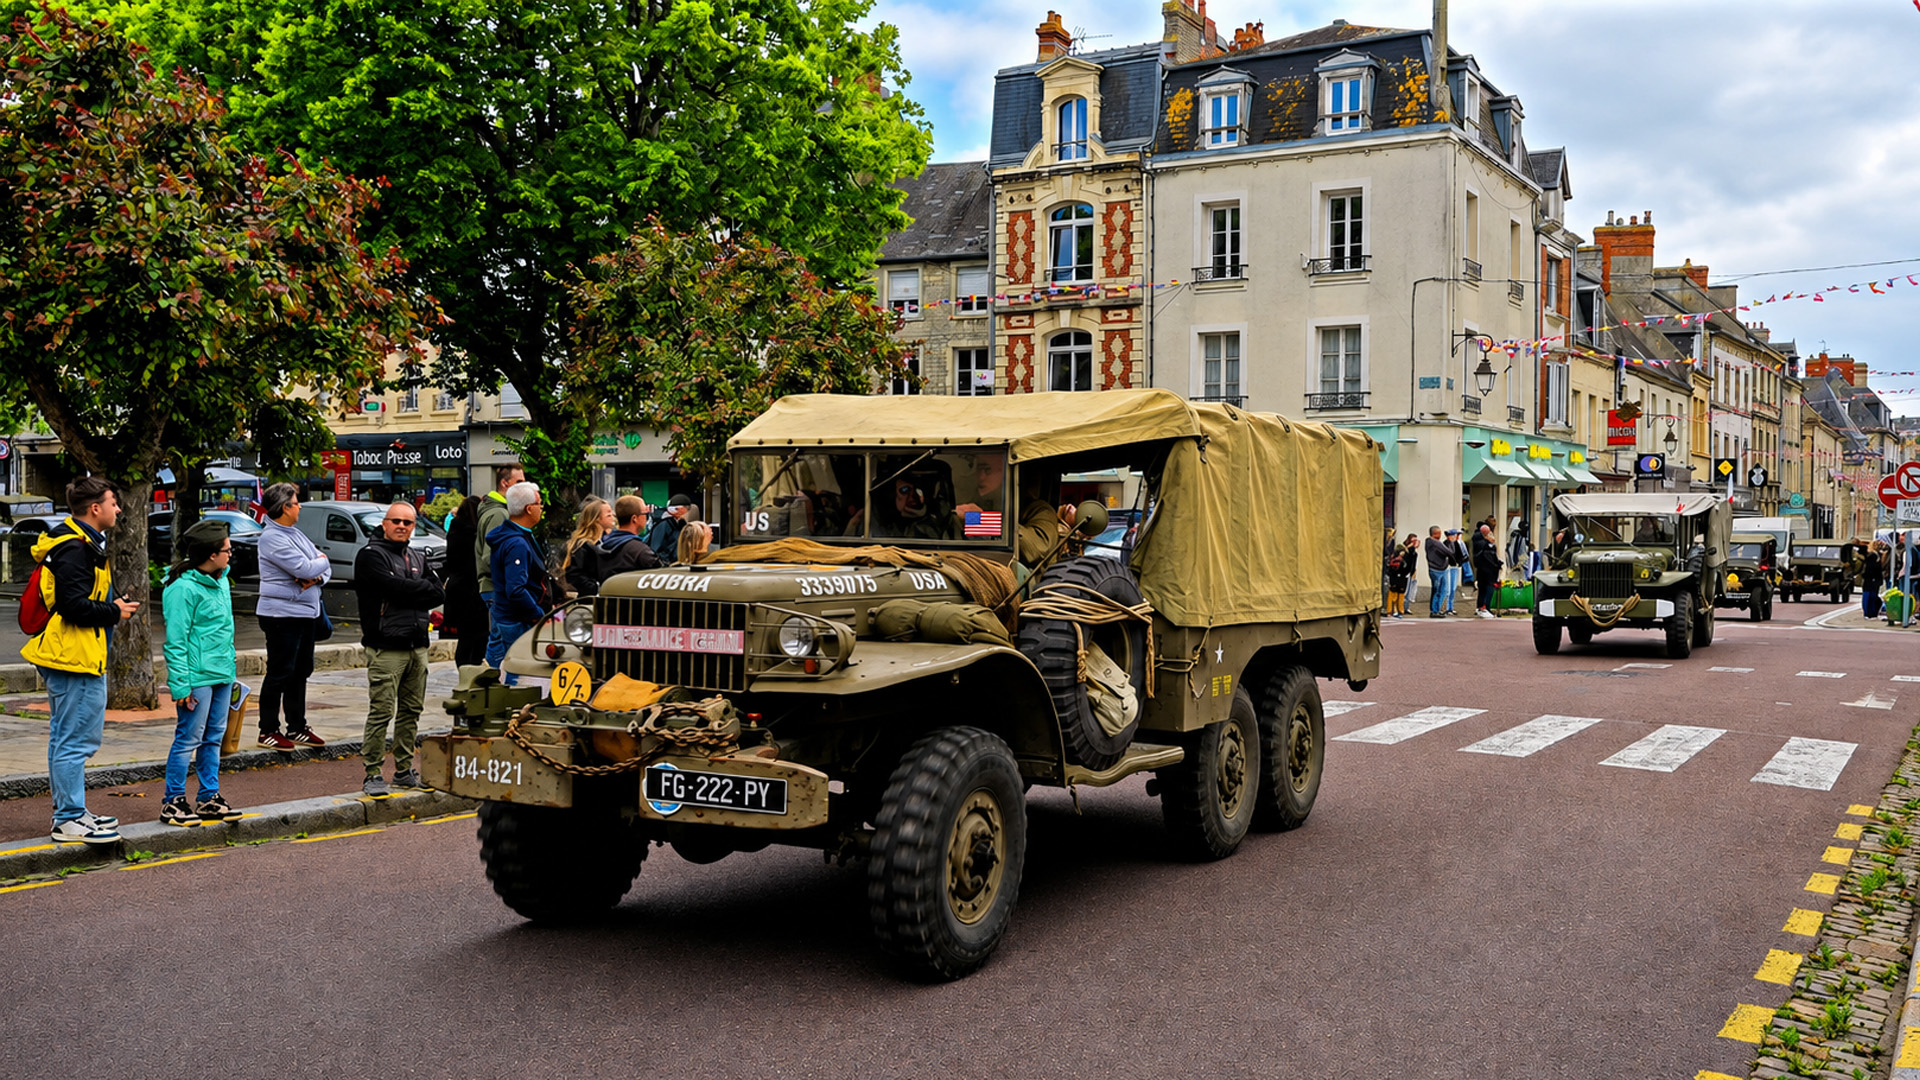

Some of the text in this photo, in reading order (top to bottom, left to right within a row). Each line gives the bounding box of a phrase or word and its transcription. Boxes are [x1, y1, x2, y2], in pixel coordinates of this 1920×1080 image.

[387, 449, 422, 465] Presse
[435, 445, 463, 459] Loto
[745, 511, 770, 532] US
[637, 573, 713, 593] COBRA
[908, 571, 948, 591] USA
[454, 755, 522, 786] 84-821
[661, 772, 770, 808] FG-222-PY
